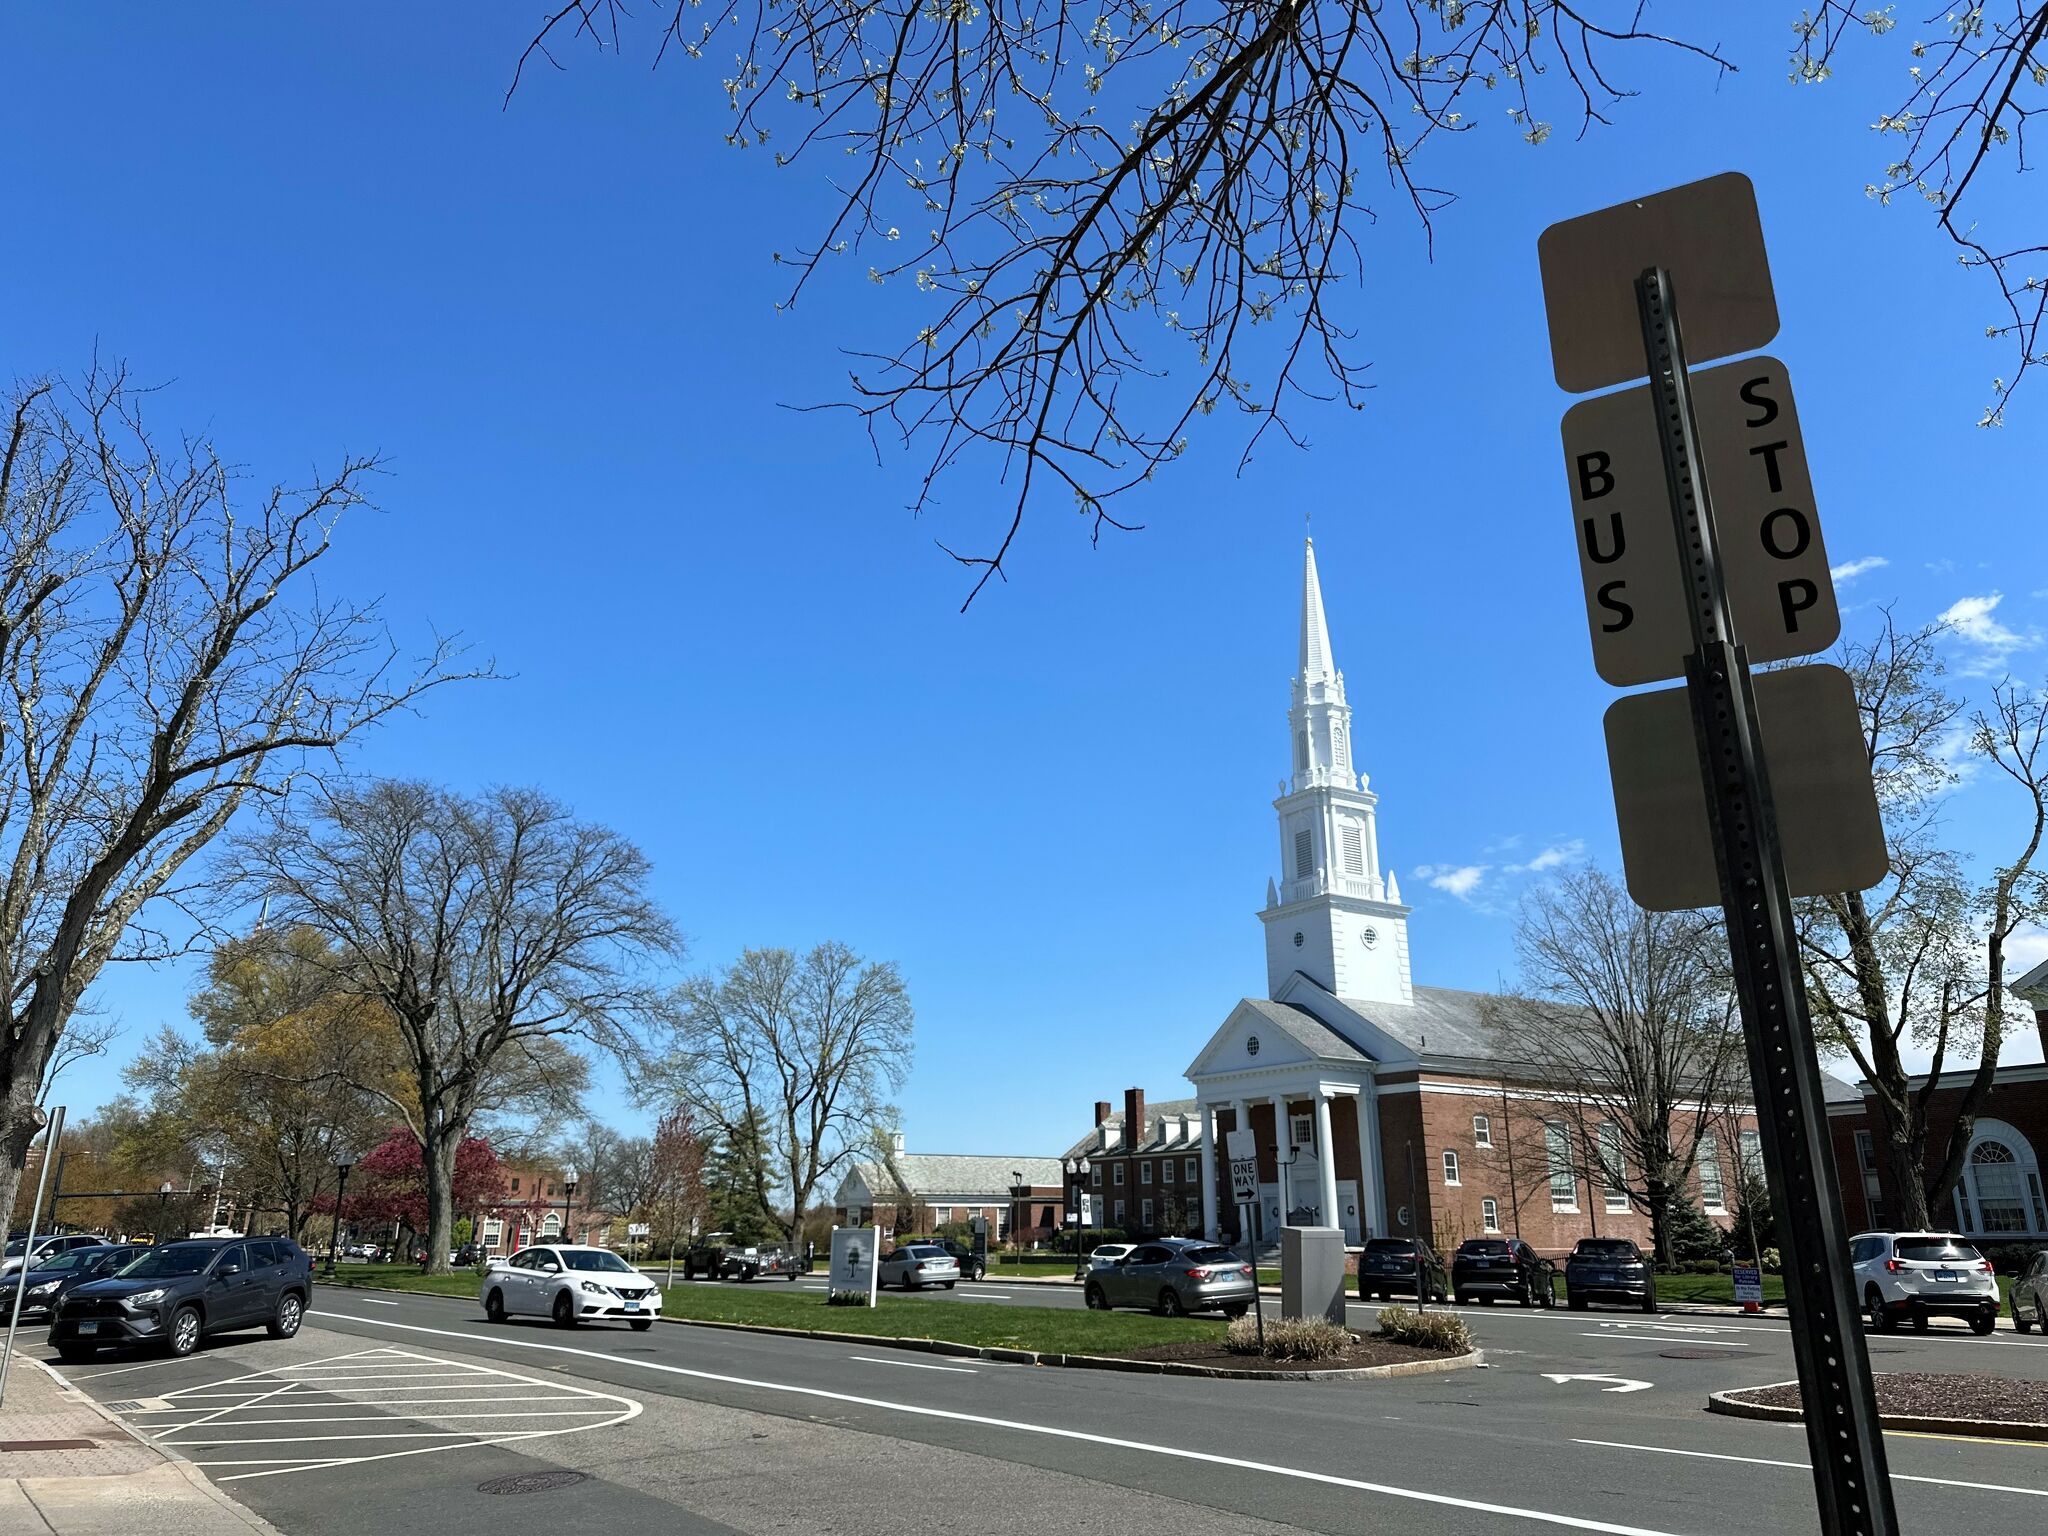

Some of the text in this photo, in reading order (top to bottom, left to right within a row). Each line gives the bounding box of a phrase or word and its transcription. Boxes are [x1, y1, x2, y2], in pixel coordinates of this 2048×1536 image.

[1576, 450, 1634, 633] BUS
[1739, 376, 1819, 633] STOP
[1233, 1163, 1254, 1175] ONE
[1234, 1175, 1255, 1187] WAY
